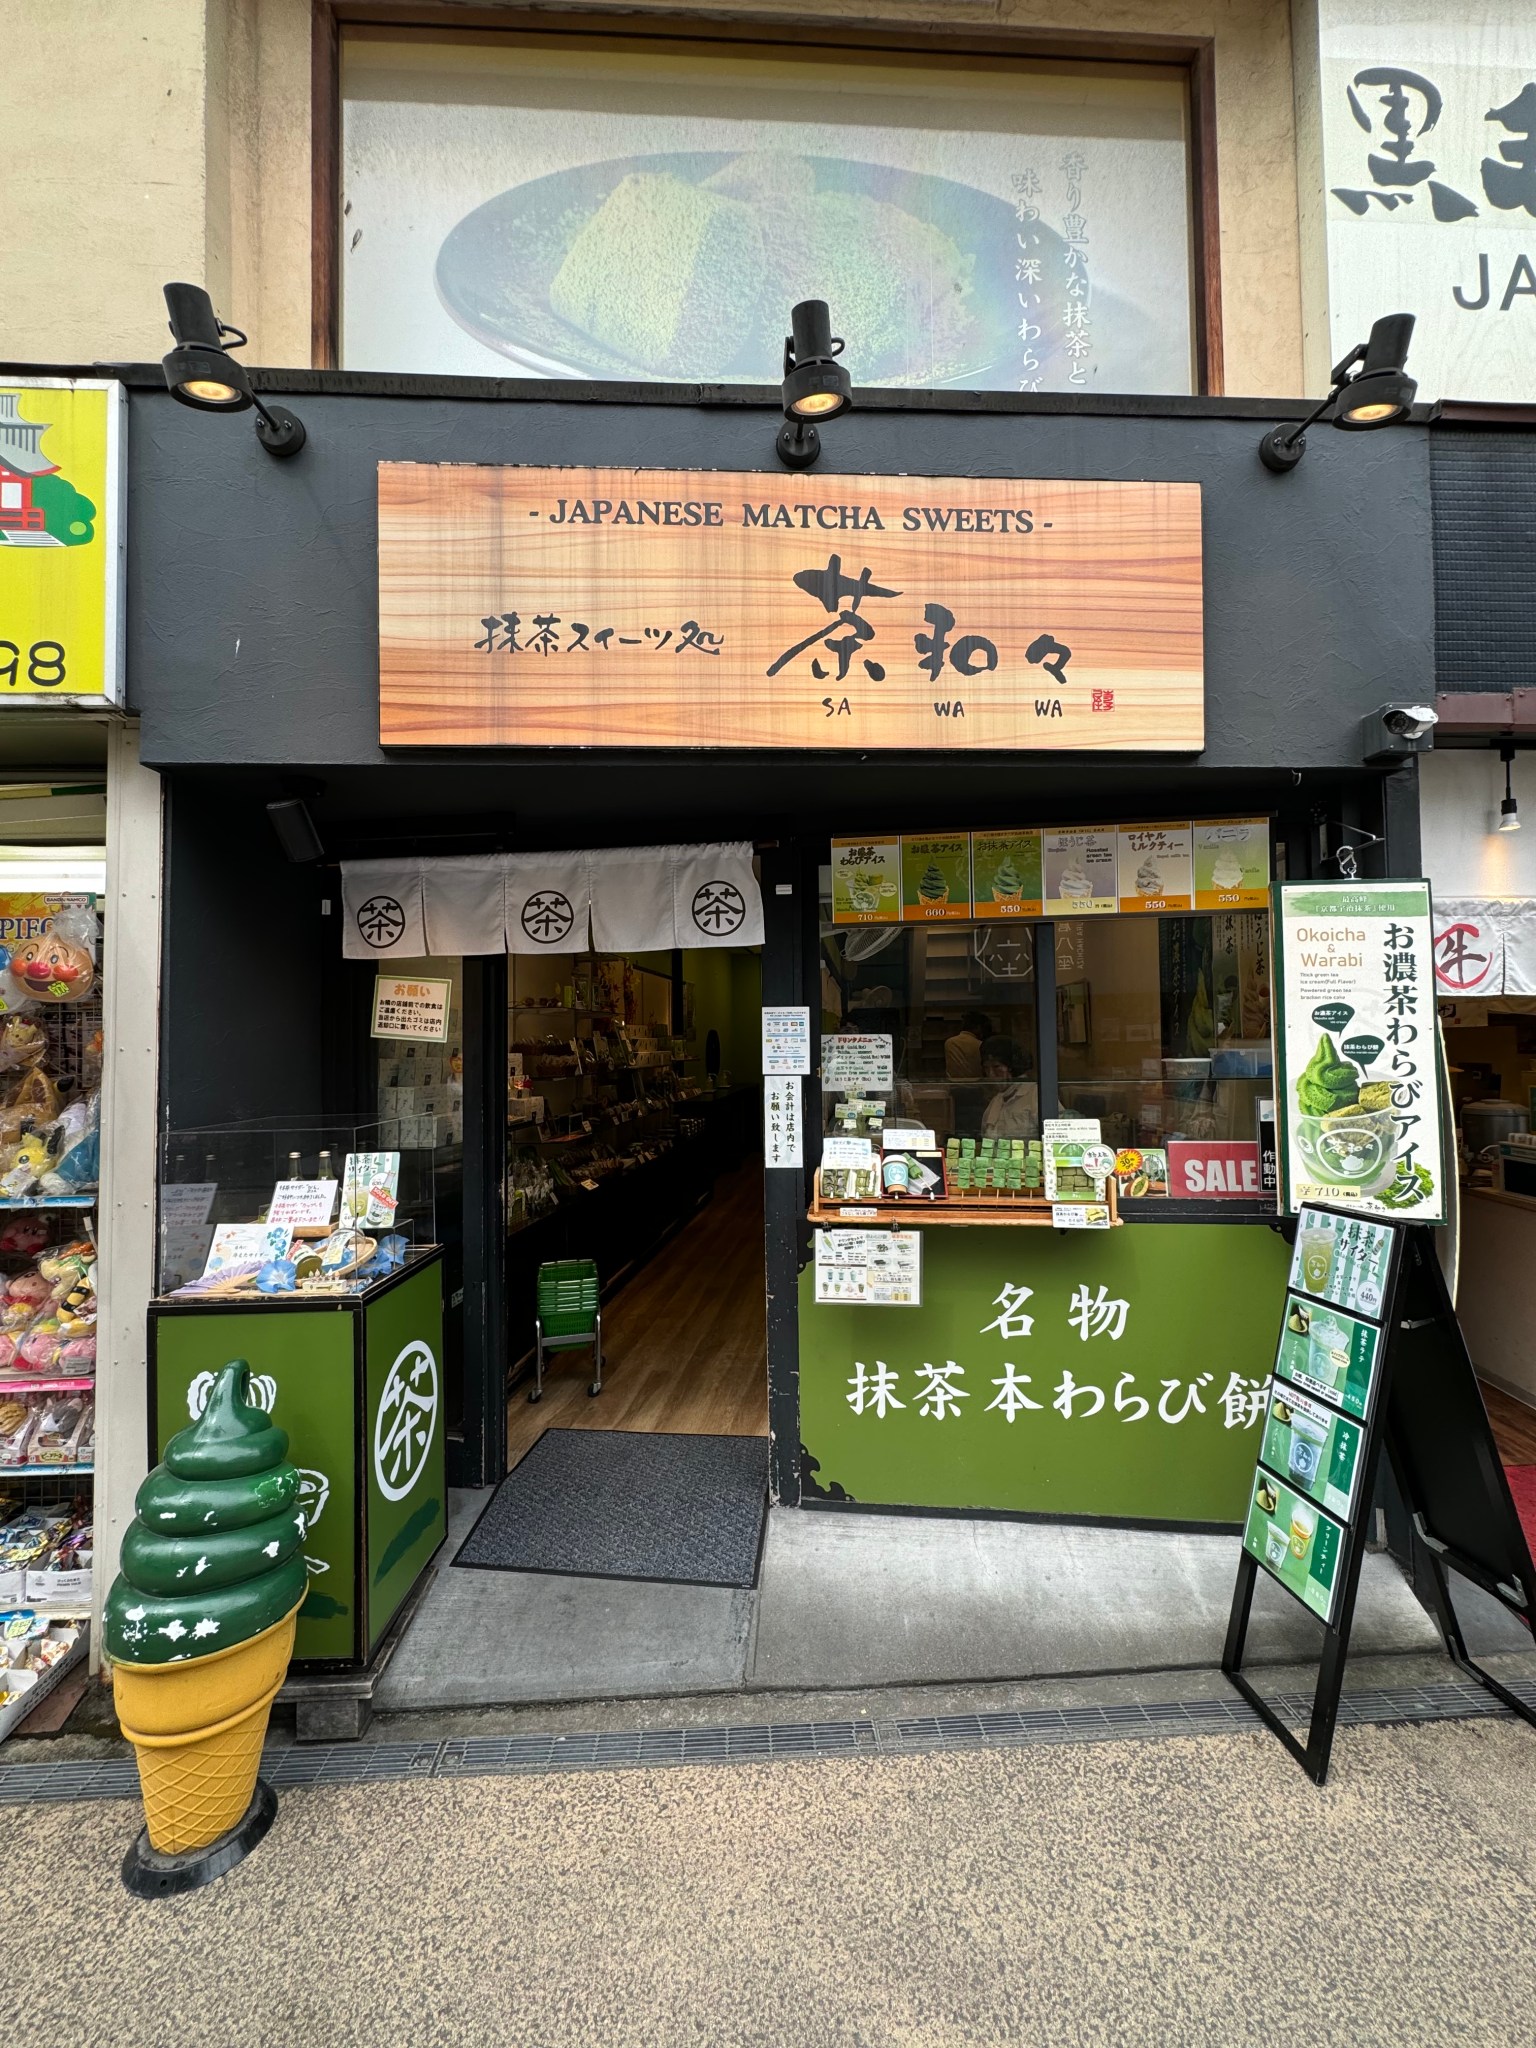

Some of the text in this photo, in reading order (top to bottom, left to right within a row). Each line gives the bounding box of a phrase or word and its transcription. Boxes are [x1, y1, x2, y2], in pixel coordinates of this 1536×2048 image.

[1059, 151, 1092, 385] 香り豊かな抹茶と
[549, 499, 723, 527] JAPANESE
[743, 503, 885, 530] MATCHA
[903, 507, 1034, 534] SWEETS
[766, 553, 1073, 684] 茶和々
[474, 610, 725, 657] 抹茶スイーツ処
[822, 697, 1063, 718] SA WA WA
[977, 839, 1033, 851] お抹茶アイス
[1057, 834, 1097, 848] ほうじ茶
[1128, 832, 1166, 842] ロイヤル
[1130, 841, 1185, 851] ミルクティー
[1206, 827, 1251, 841] バニラ
[839, 855, 886, 866] わらびアイス
[695, 887, 744, 929] 茶
[1000, 904, 1021, 914] 550
[1144, 900, 1166, 909] 550
[1218, 893, 1241, 903] 550
[361, 900, 403, 942] 茶
[526, 897, 572, 938] 茶
[925, 908, 947, 917] 660
[1296, 927, 1366, 942] Okoicha
[1300, 953, 1363, 967] Warabi
[1327, 943, 1336, 953] &
[1439, 928, 1487, 985] 牛
[393, 983, 431, 997] お願い
[378, 1007, 422, 1016] ご遠慮ください。
[379, 1000, 443, 1010] お隣の店舗前での飲食は
[377, 1022, 442, 1032] 返却口に置いてください
[378, 1014, 442, 1025] 当店から出たゴミは店内
[1382, 922, 1425, 1204] お濃茶わらびアイス
[770, 1091, 781, 1163] お願い致します
[785, 1081, 796, 1152] お会計は店内で
[1184, 1159, 1259, 1192] SALE
[1263, 1150, 1276, 1188] 作動中
[373, 1187, 386, 1199] SOLD
[1347, 1221, 1376, 1248] 抹茶
[1339, 1238, 1379, 1265] サイダー
[1357, 1328, 1369, 1363] 抹茶ラテ
[845, 1360, 1276, 1430] 抹茶本わらび餅
[380, 1355, 436, 1482] 茶
[1337, 1431, 1350, 1462] 冷抹茶
[1318, 1525, 1333, 1575] グリーンティー
